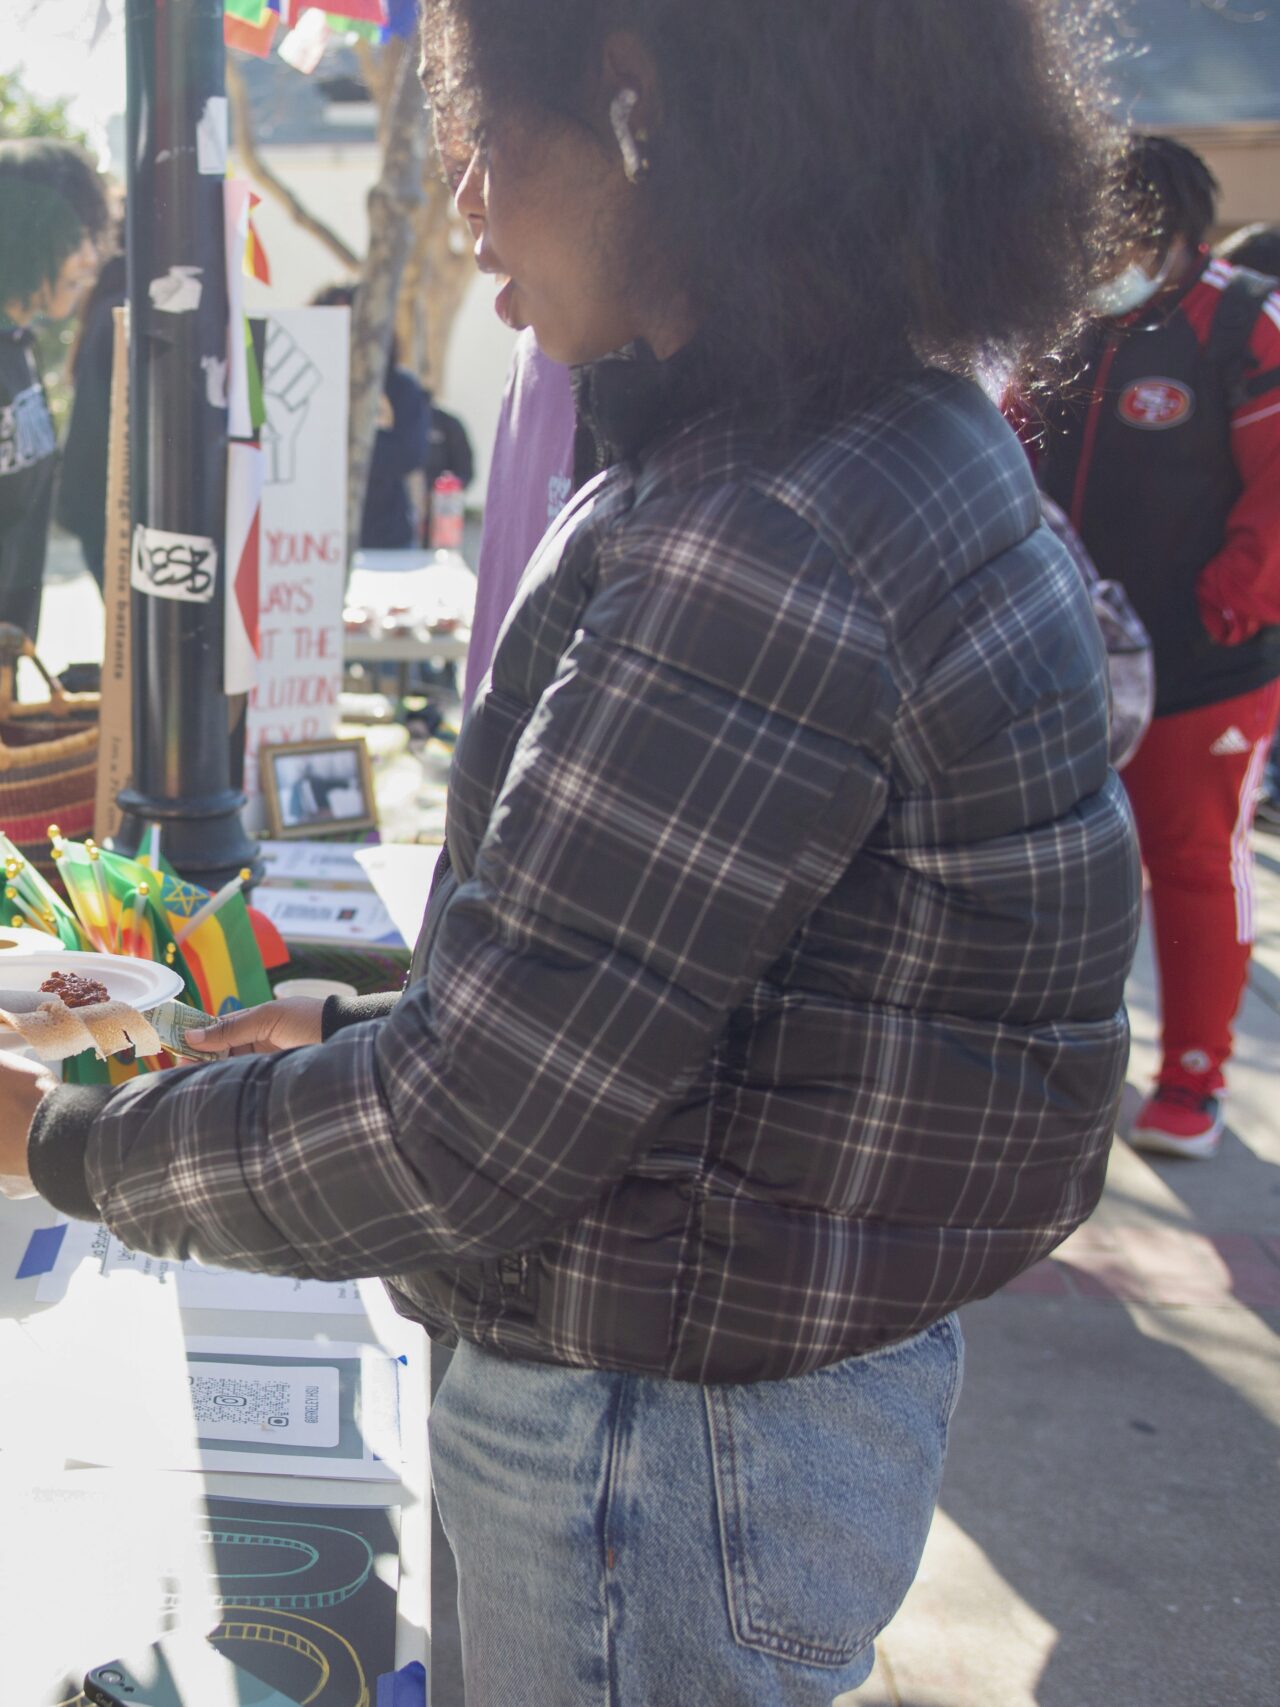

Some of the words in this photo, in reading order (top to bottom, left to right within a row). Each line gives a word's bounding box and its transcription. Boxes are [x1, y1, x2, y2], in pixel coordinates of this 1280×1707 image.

[265, 529, 341, 566] YOUNG
[289, 624, 337, 659] THE
[249, 672, 341, 712] LUTION
